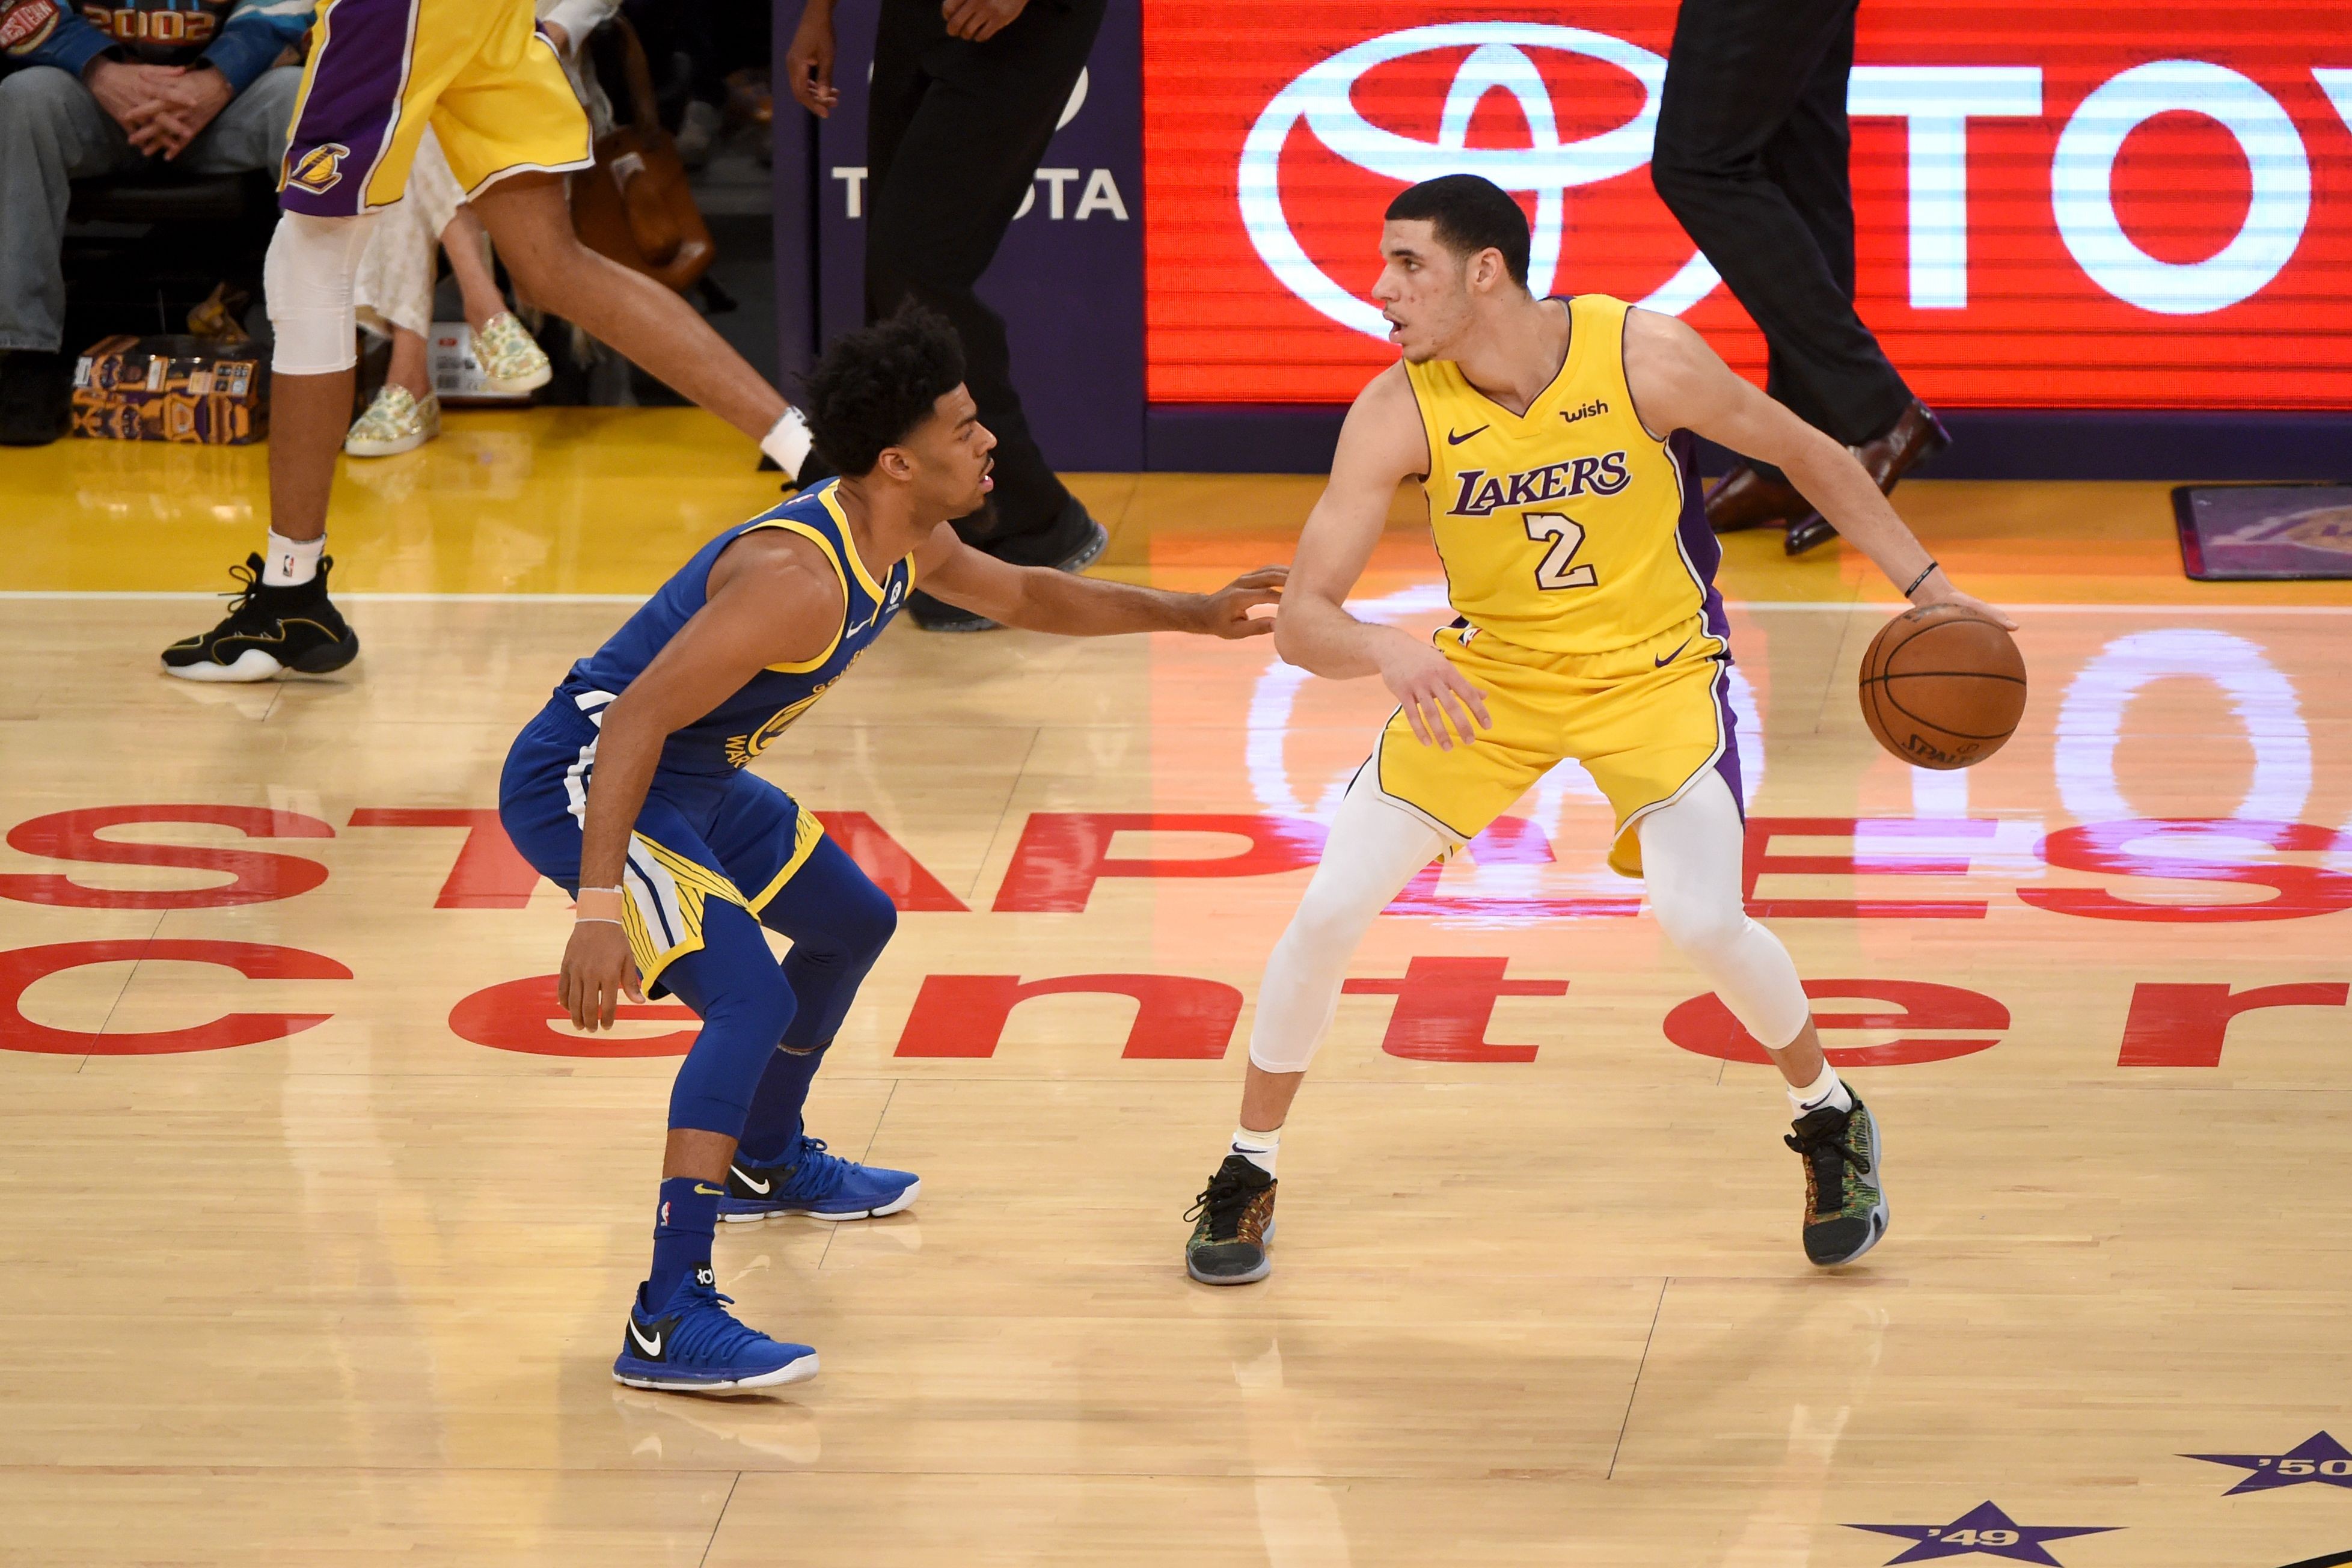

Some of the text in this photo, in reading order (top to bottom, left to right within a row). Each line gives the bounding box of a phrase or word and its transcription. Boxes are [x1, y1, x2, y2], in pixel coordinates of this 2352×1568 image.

[832, 167, 1130, 221] TTA
[1847, 59, 2352, 314] TO
[1560, 399, 1608, 423] wish
[1446, 450, 1632, 517] LAKERS
[1522, 512, 1598, 590] 2
[1927, 1529, 2020, 1546] '49
